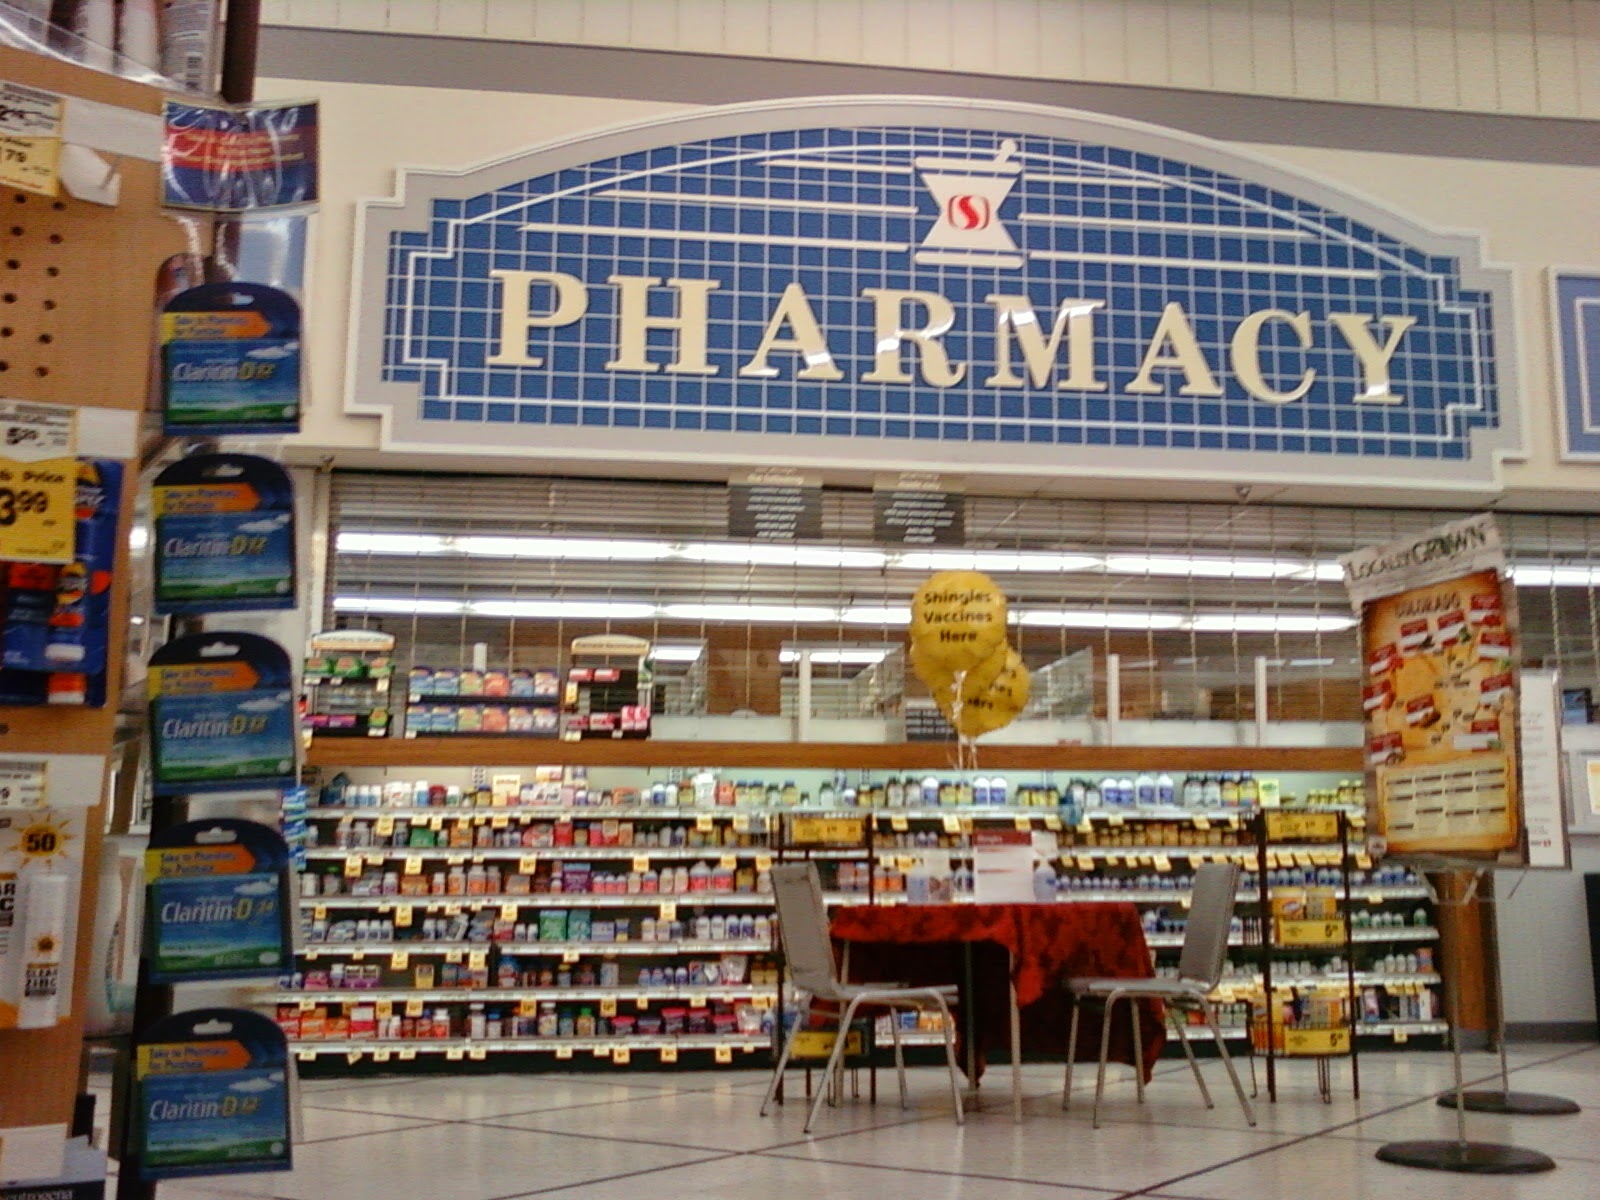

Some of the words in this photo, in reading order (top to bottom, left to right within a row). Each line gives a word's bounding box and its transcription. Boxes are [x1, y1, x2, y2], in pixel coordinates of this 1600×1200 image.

[484, 268, 1418, 405] PHARMACY
[924, 589, 991, 605] Shingles
[923, 609, 993, 624] Vaccines
[940, 630, 978, 643] Here
[26, 833, 57, 852] 50
